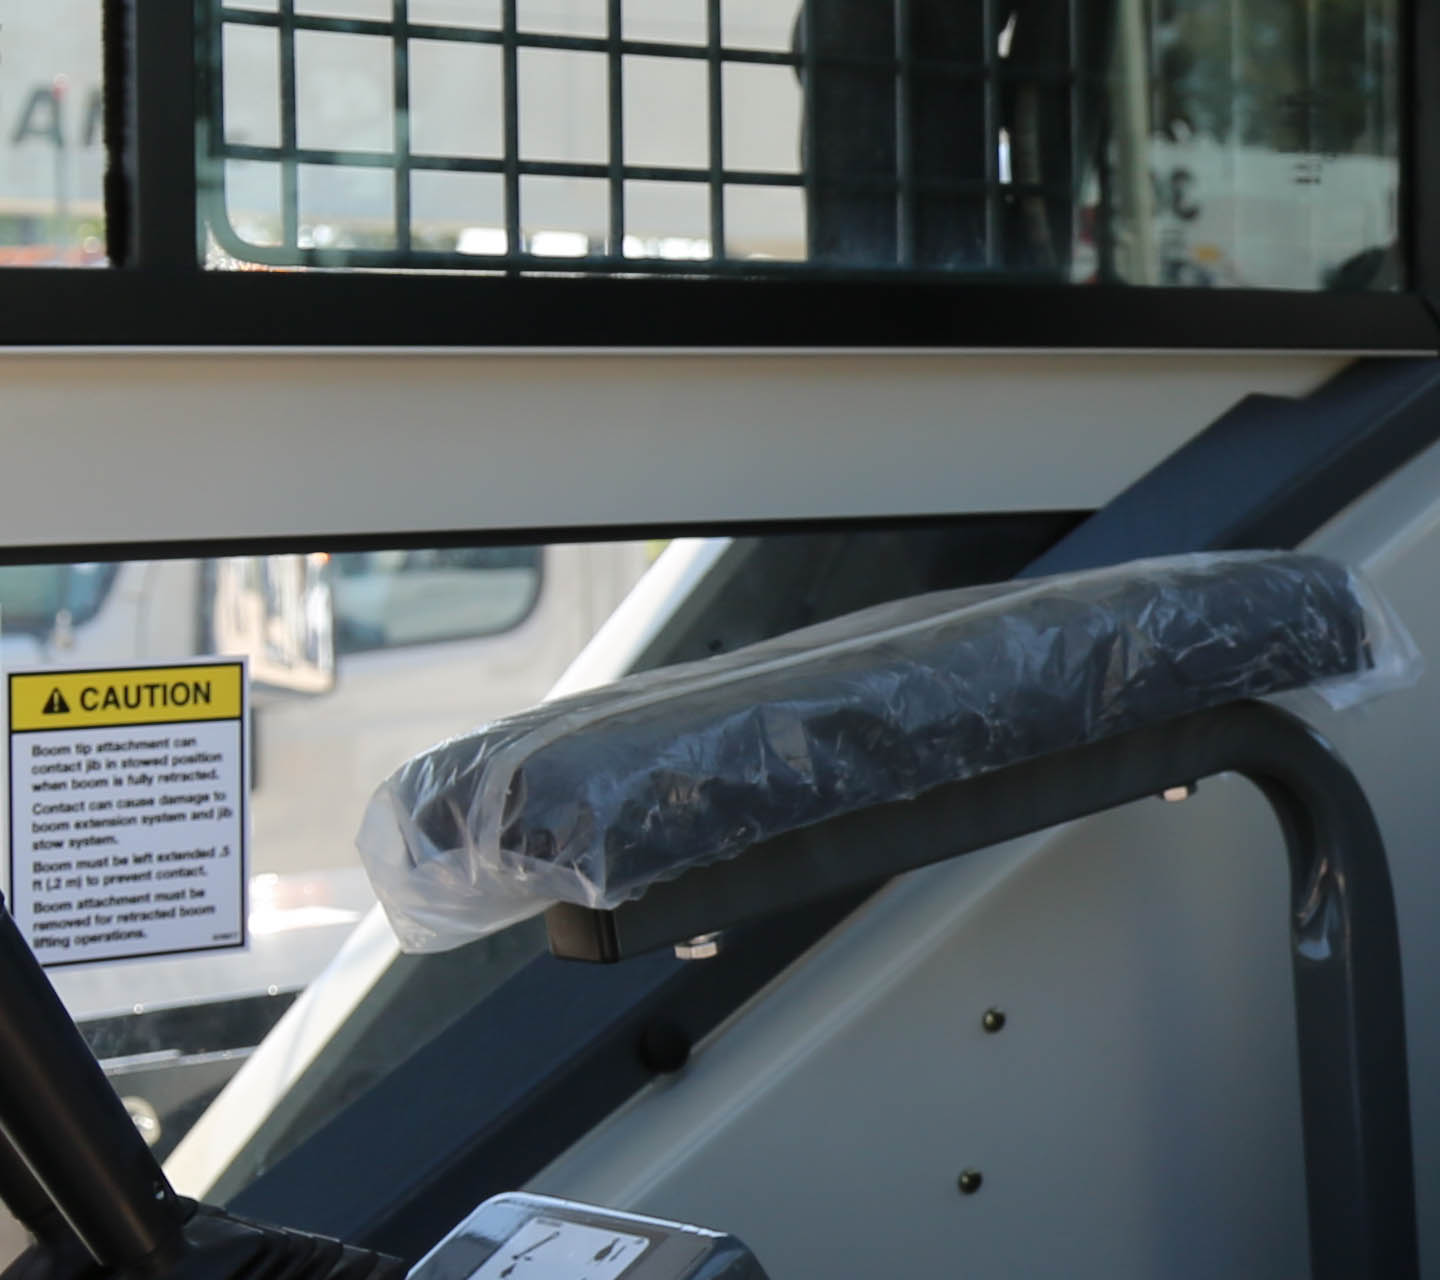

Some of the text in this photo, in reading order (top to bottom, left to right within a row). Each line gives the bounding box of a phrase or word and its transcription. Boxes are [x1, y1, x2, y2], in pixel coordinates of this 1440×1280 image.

[80, 682, 212, 711] CAUTION
[31, 737, 197, 757] Boom tip attachment can
